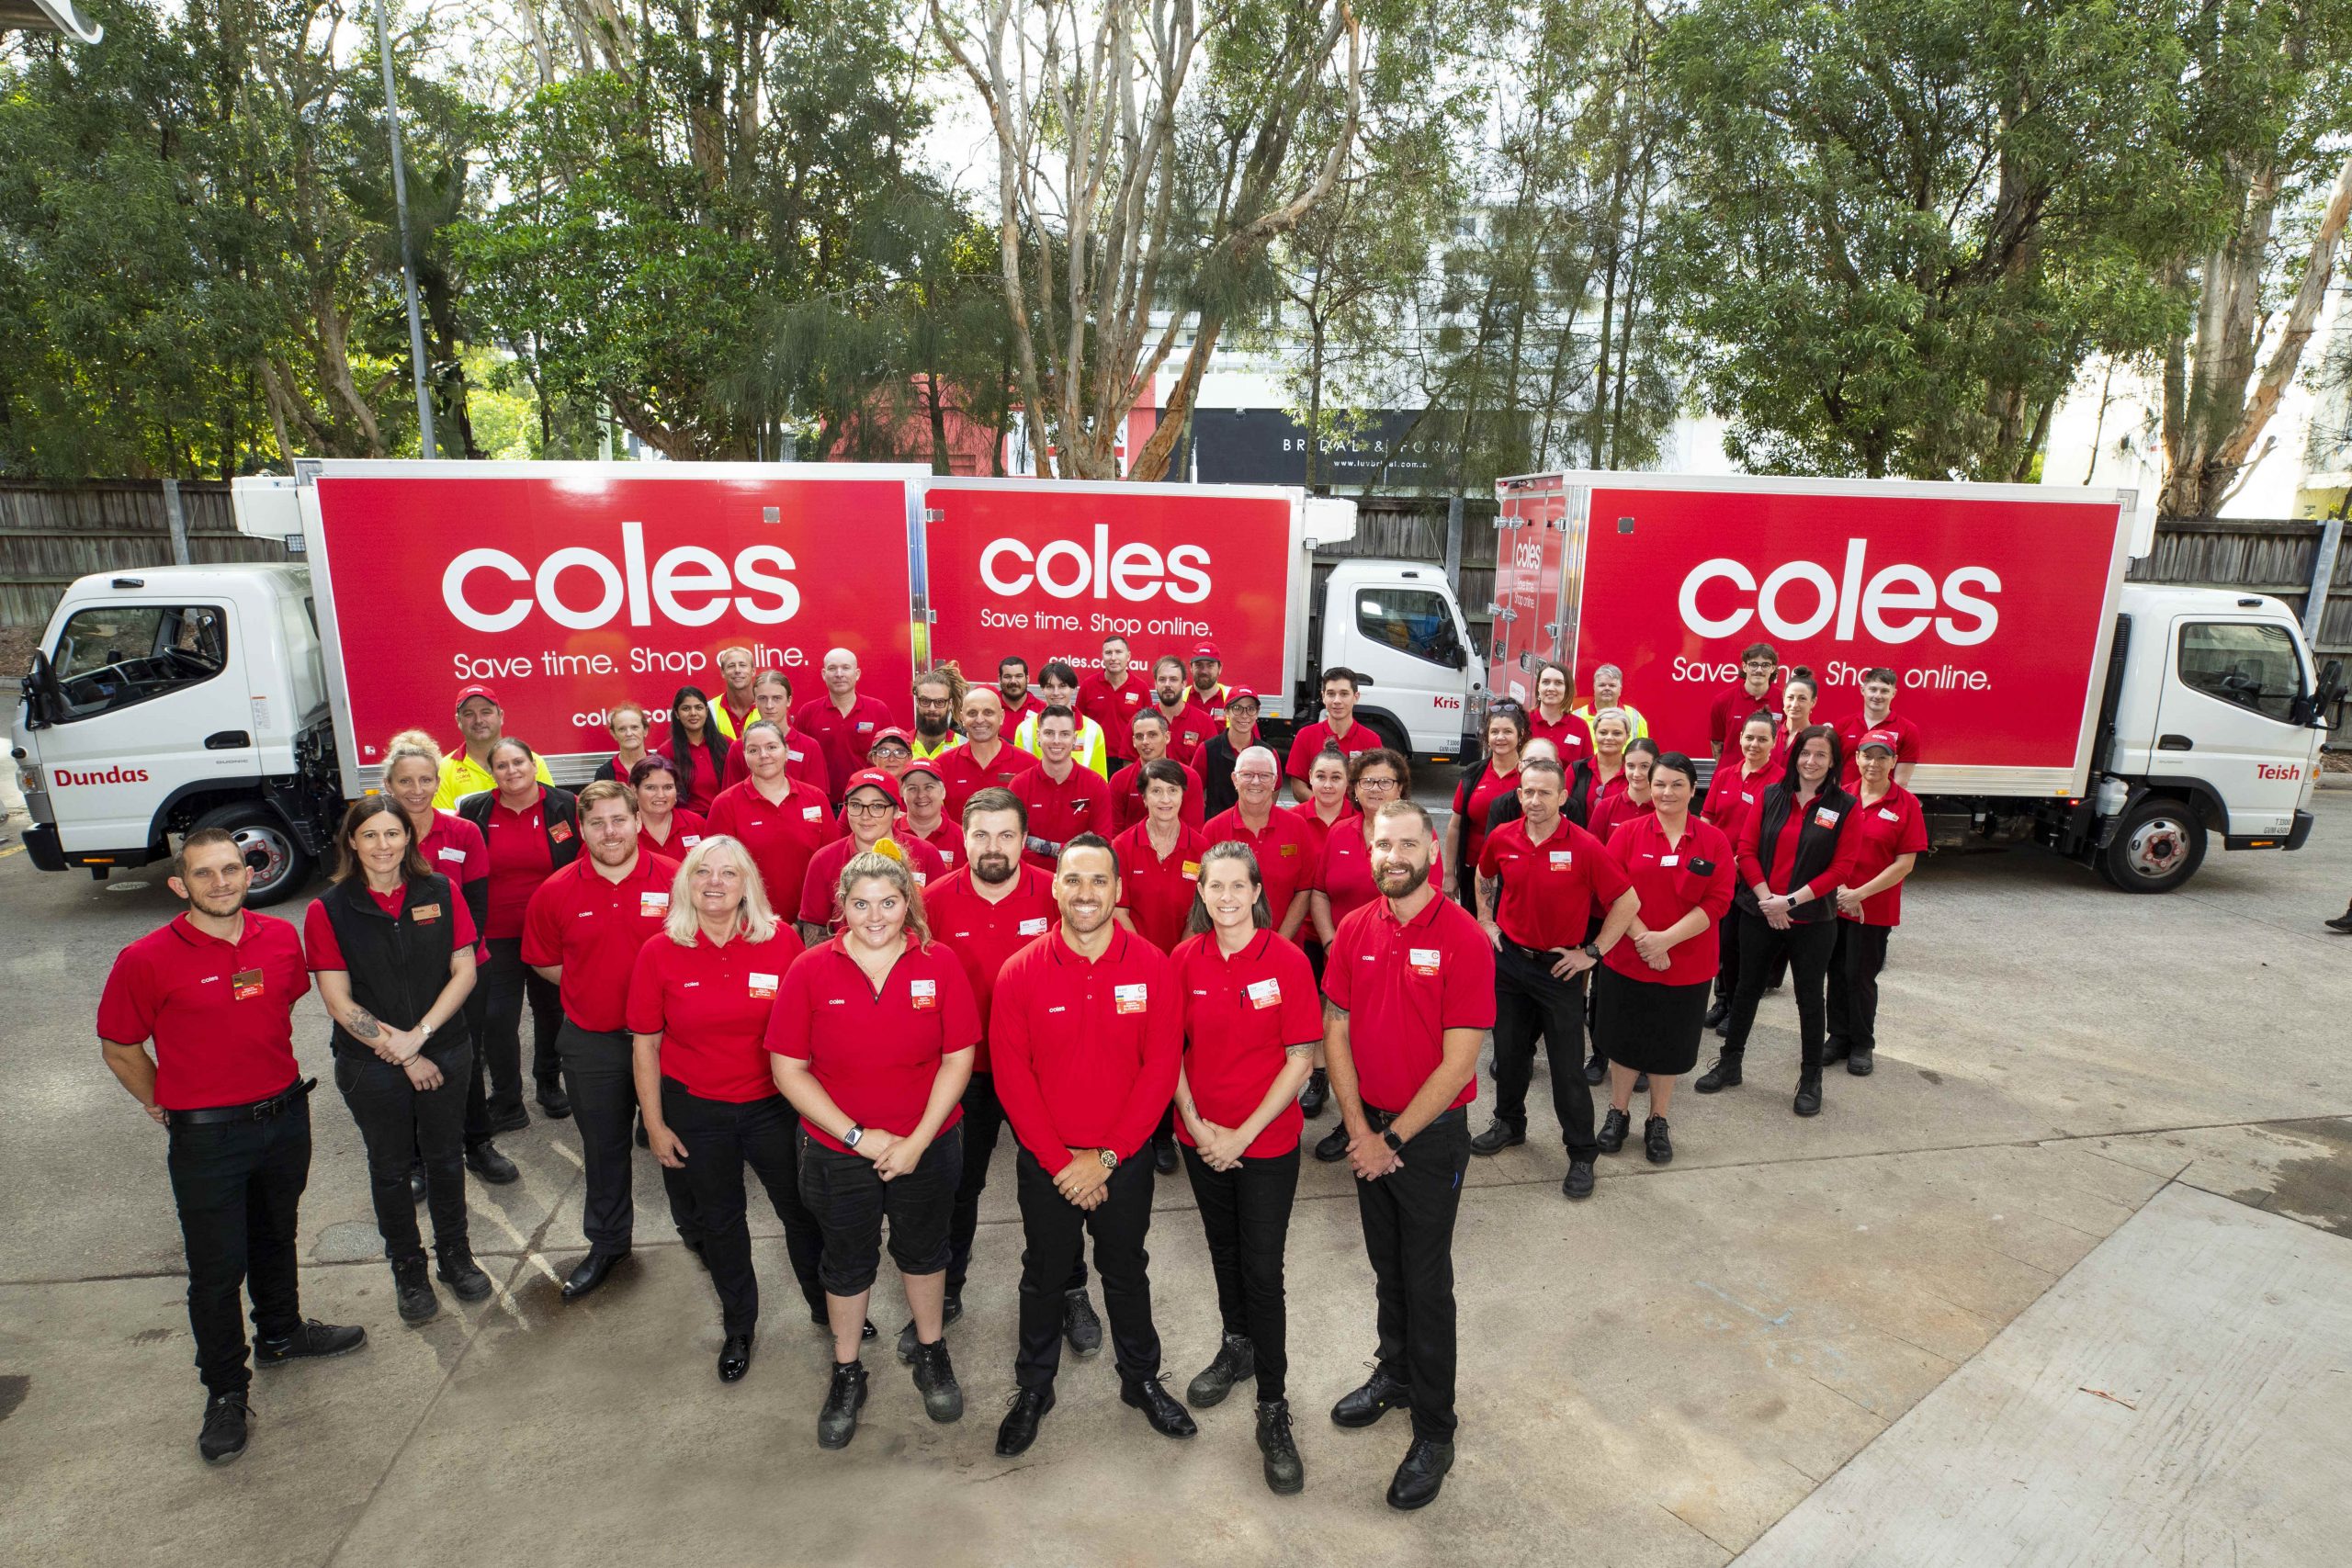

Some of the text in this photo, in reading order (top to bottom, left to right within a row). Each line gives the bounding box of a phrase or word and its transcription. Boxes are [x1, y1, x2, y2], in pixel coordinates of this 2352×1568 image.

[1283, 438, 1359, 452] BRDAL
[1374, 440, 1385, 452] &
[980, 523, 1211, 604] coles
[1516, 536, 1541, 570] coles
[442, 521, 800, 632] coles
[1678, 538, 2001, 647] coles
[980, 608, 1213, 637] Save time. Shop online.
[454, 644, 808, 680] Save time. Shop line.
[1672, 656, 1739, 682] Save
[1826, 660, 1876, 686] Sho
[1905, 665, 1991, 690] online.
[1434, 696, 1460, 709] Kris
[54, 765, 149, 787] Dundas
[2257, 764, 2300, 780] Teish
[201, 976, 219, 984] coles
